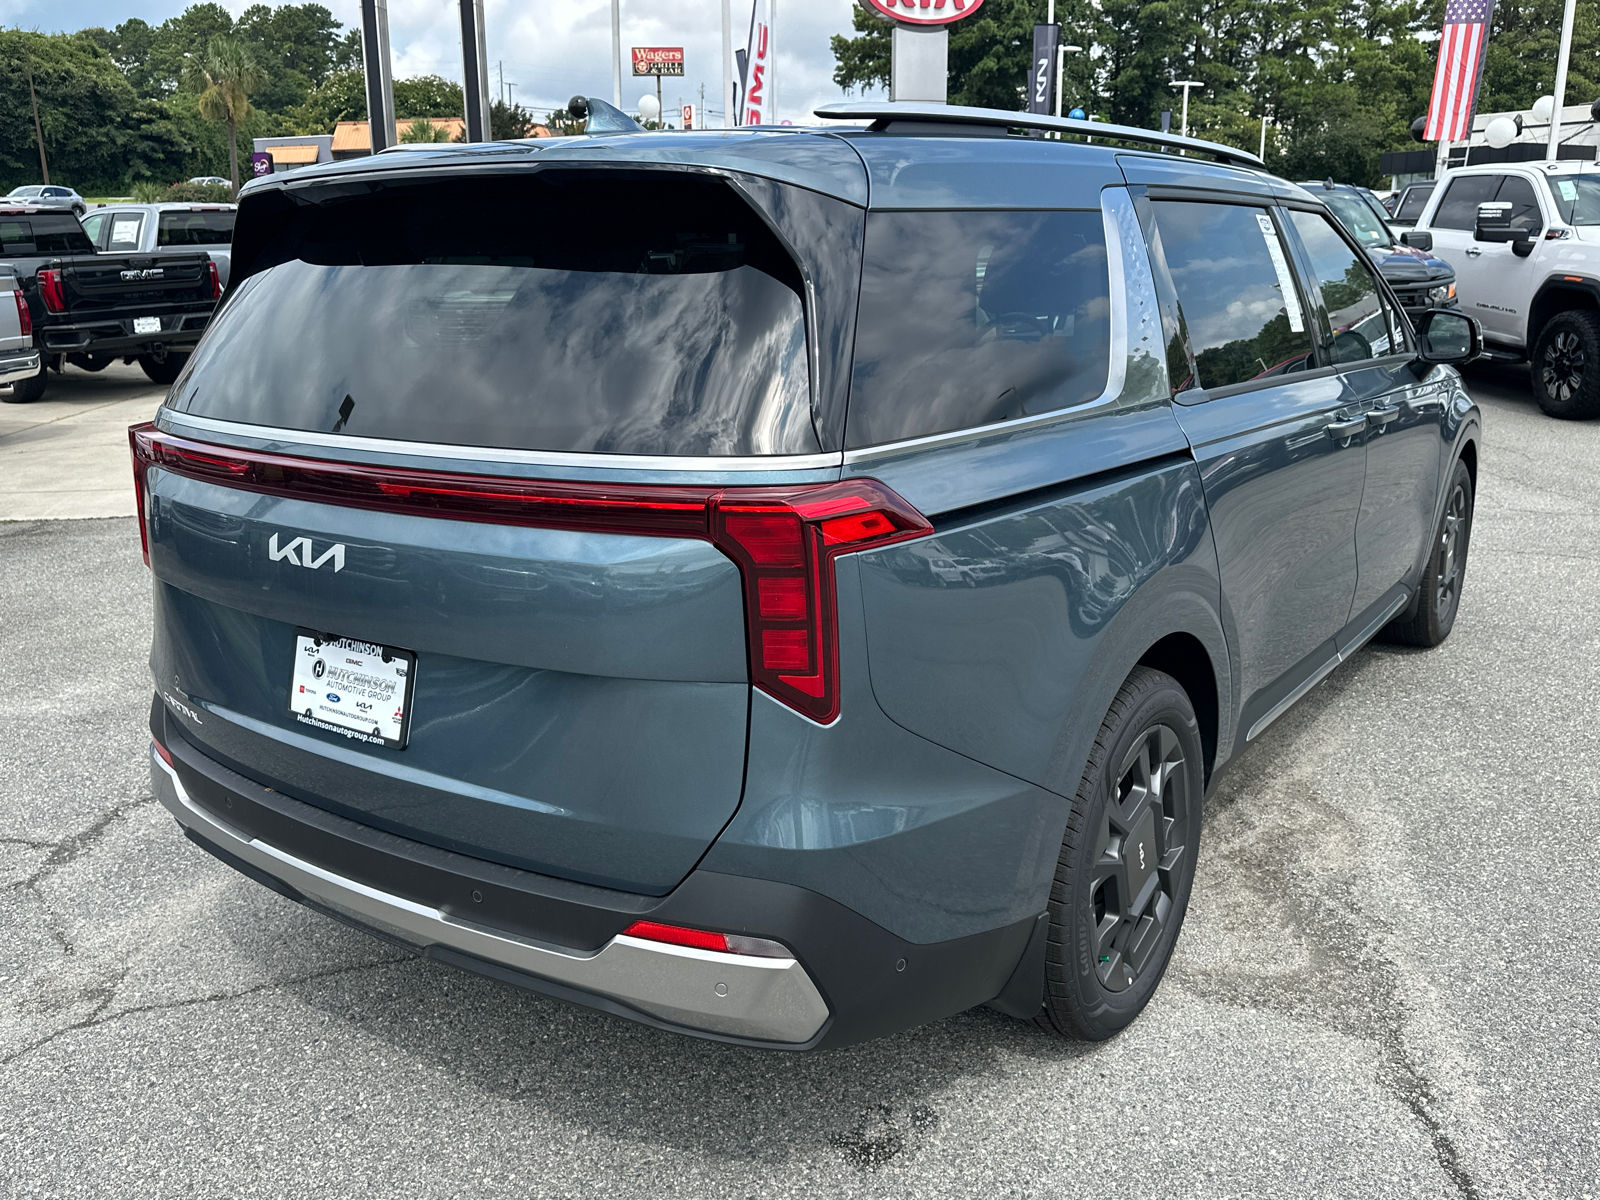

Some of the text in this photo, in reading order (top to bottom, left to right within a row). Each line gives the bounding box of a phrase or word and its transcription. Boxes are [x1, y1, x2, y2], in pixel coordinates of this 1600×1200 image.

[634, 48, 682, 62] Wagers
[120, 268, 165, 280] GMC
[268, 532, 346, 573] KIA
[304, 646, 319, 654] KIA
[346, 658, 363, 666] GMC
[326, 666, 396, 693] HUTCHINSON
[326, 680, 392, 702] AUTOMOTIVE GROUP
[356, 701, 372, 709] KIA
[319, 705, 378, 725] HUTCHINSONAUTOGROUP.COM
[297, 714, 384, 745] Hutchinsonautogroup.com
